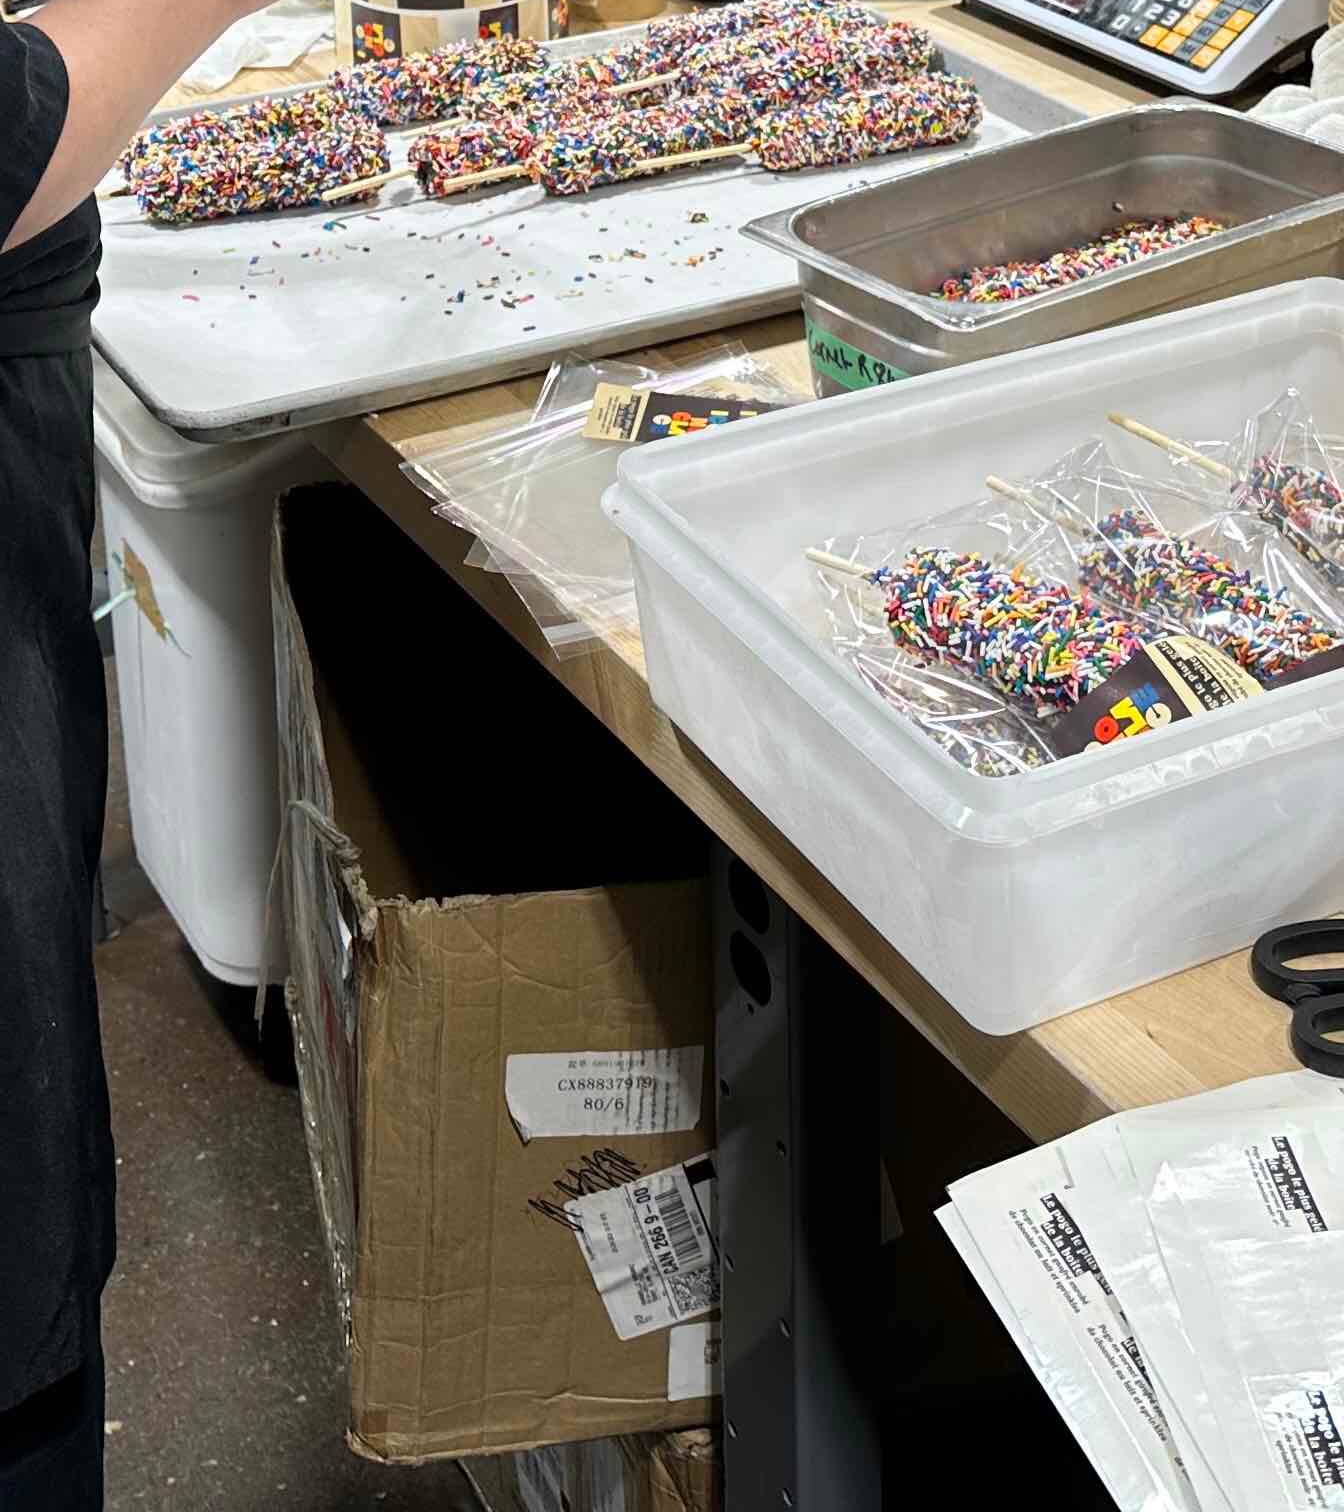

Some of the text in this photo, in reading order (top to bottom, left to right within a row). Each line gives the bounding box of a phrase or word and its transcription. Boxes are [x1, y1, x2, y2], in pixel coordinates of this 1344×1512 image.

[1144, 4, 1164, 20] 2
[1161, 10, 1181, 26] 3
[1175, 657, 1199, 684] plus
[1208, 680, 1220, 693] la
[584, 1097, 624, 1112] 80/6
[1272, 1137, 1287, 1148] Le
[1265, 1158, 1282, 1171] de
[1276, 1151, 1298, 1175] pogo
[1272, 1172, 1287, 1182] la
[1290, 1177, 1305, 1186] le
[1042, 1193, 1056, 1209] Le
[1294, 1189, 1316, 1210] plus
[1049, 1208, 1074, 1236] pogo
[647, 1224, 669, 1250] 266
[1042, 1220, 1058, 1236] de
[1052, 1234, 1068, 1251] la
[1070, 1234, 1083, 1247] le
[657, 1249, 678, 1275] CAN
[1075, 1245, 1099, 1273] plus
[1309, 1408, 1335, 1439] pogo
